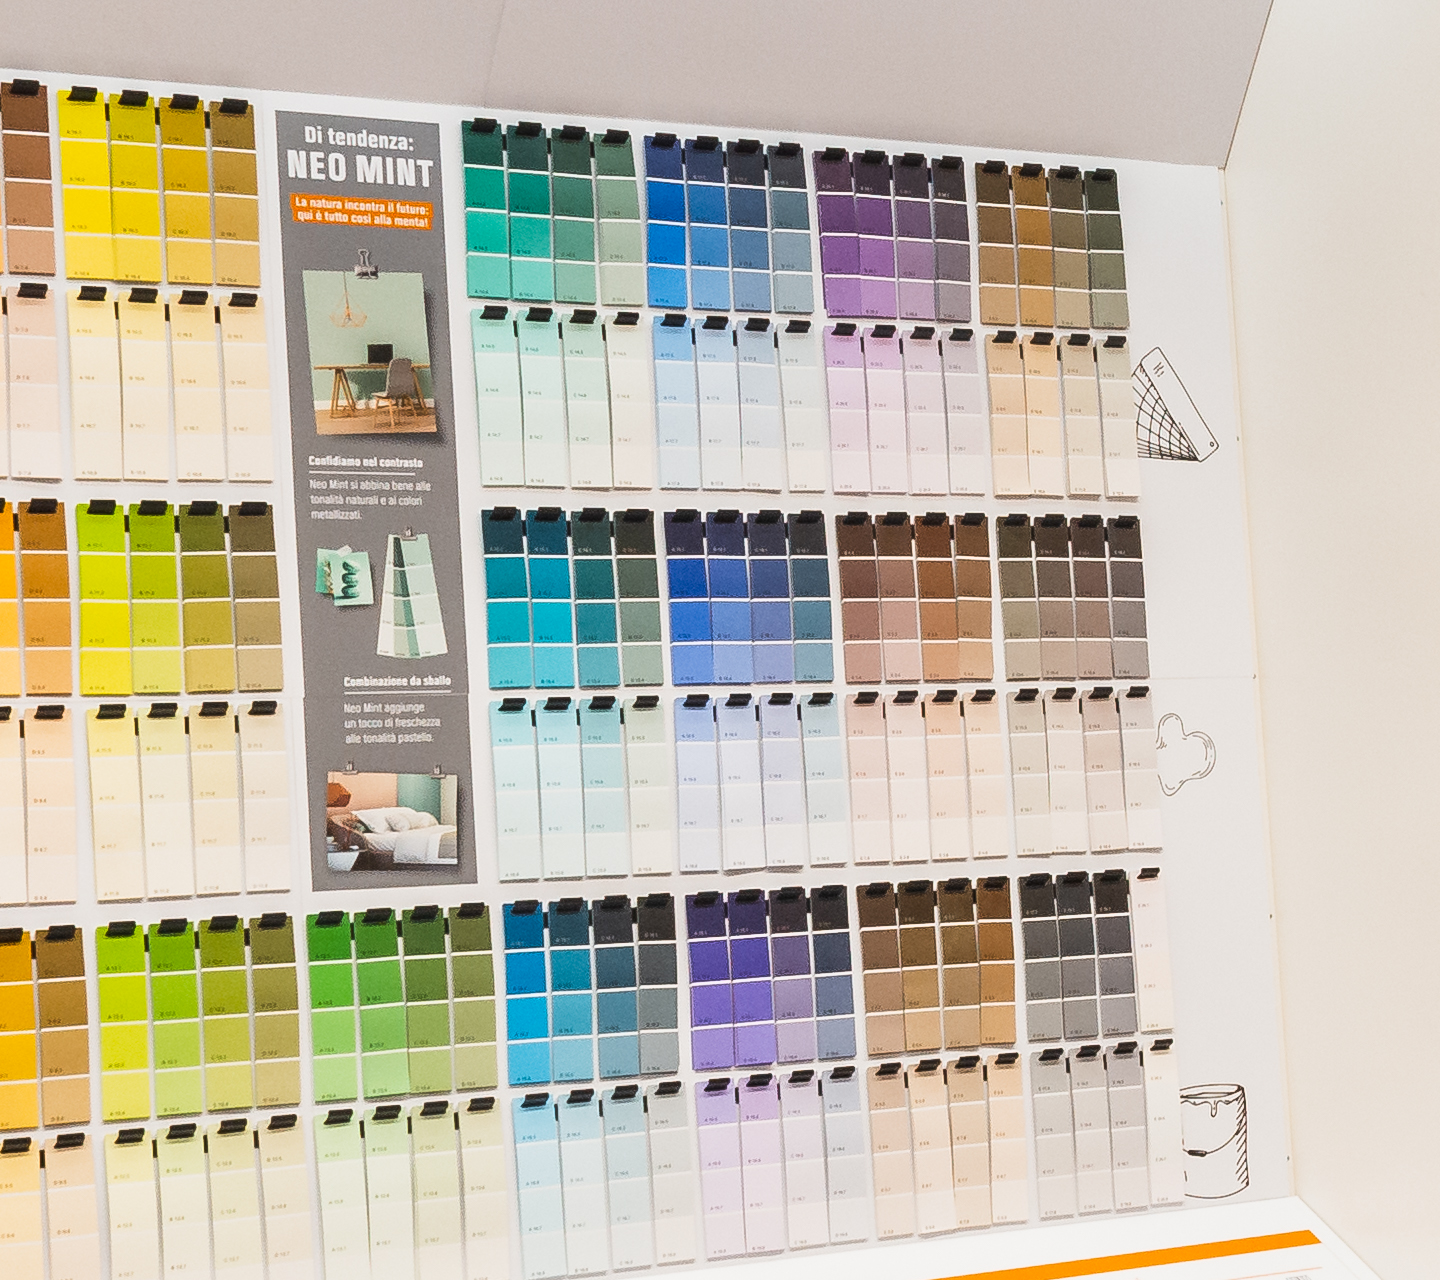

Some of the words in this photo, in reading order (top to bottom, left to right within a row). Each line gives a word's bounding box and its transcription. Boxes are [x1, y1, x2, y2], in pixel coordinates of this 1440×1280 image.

[304, 126, 322, 144] Di
[328, 127, 414, 151] tendenza:
[287, 150, 347, 182] NEO
[356, 154, 433, 187] MINT
[295, 196, 307, 207] La
[310, 198, 342, 209] natura
[345, 200, 385, 213] incontra
[388, 202, 394, 213] il
[396, 203, 429, 215] futuro:
[298, 210, 312, 222] qui
[324, 211, 348, 223] tutto
[374, 214, 391, 225] alla
[394, 216, 428, 227] menta!
